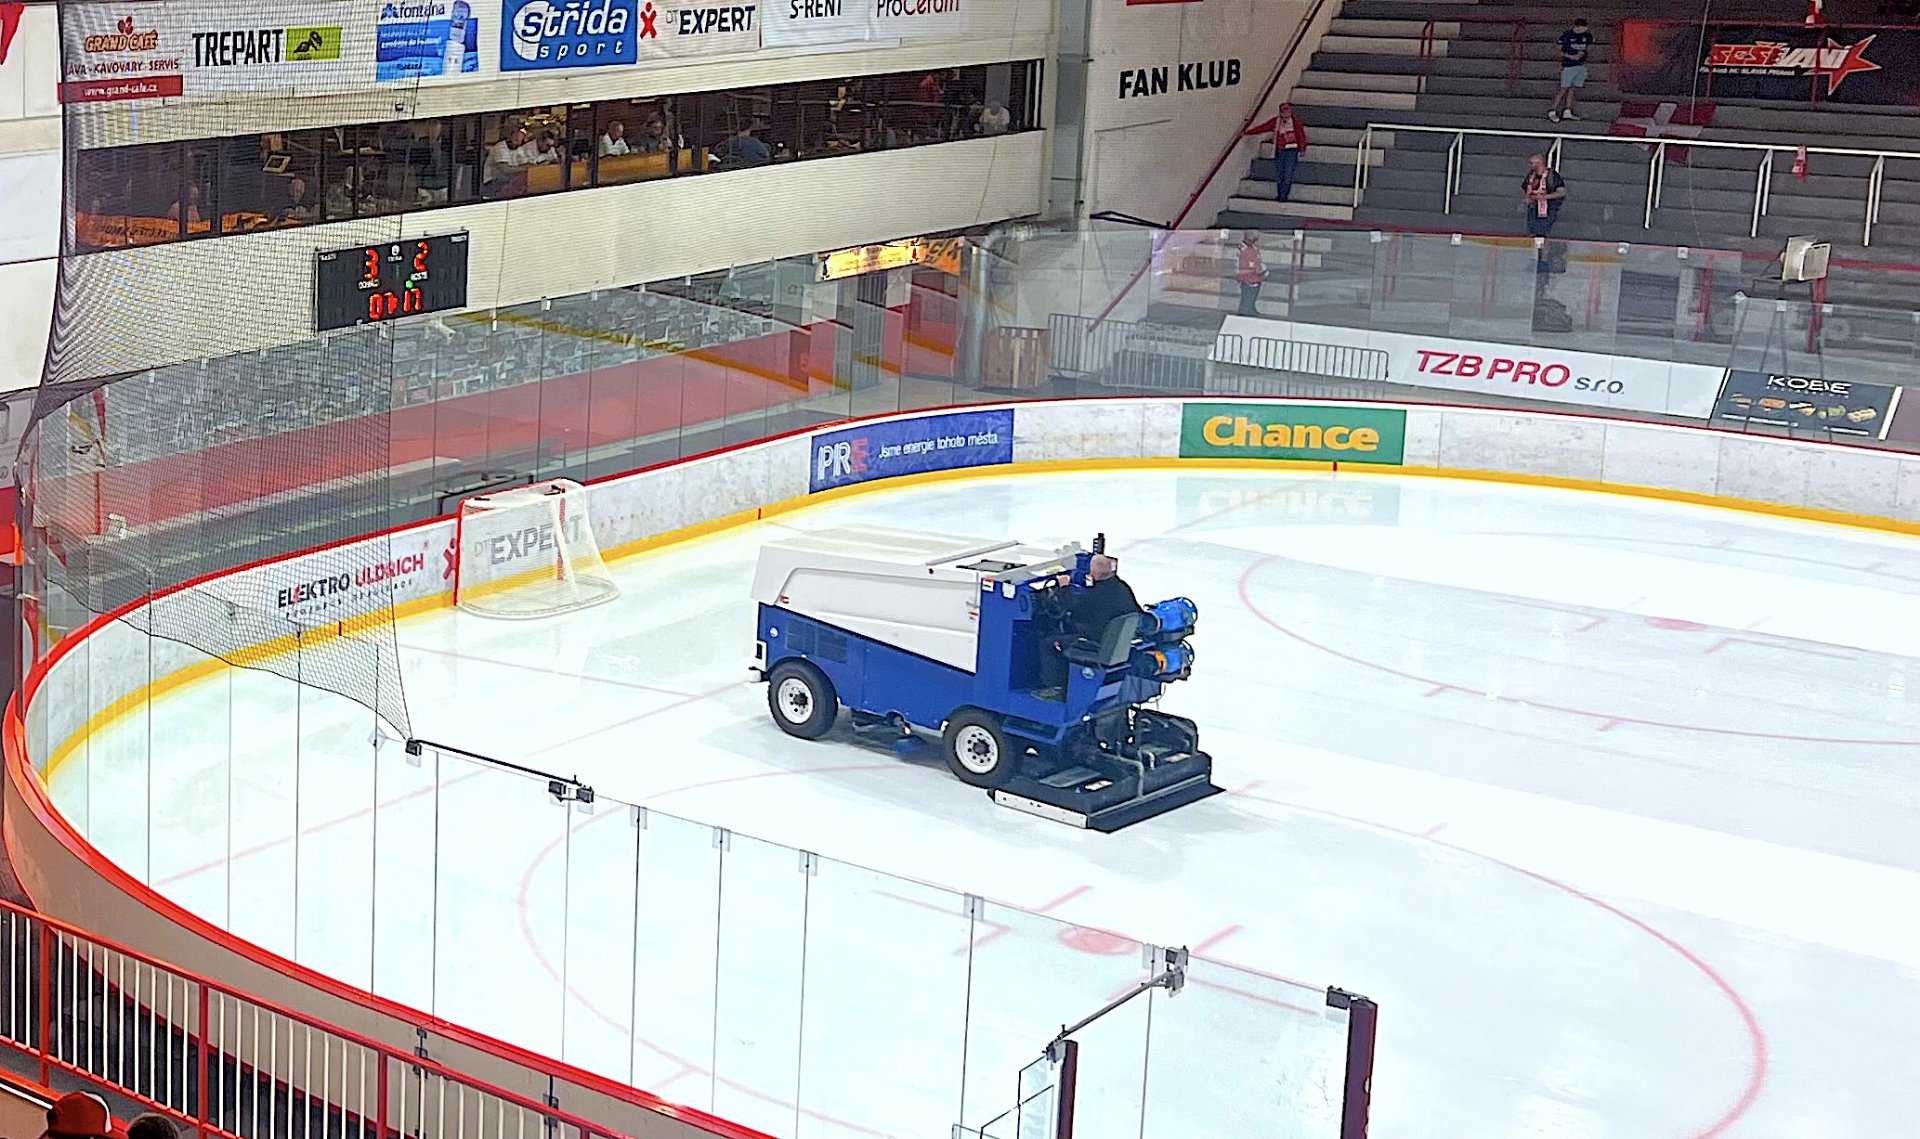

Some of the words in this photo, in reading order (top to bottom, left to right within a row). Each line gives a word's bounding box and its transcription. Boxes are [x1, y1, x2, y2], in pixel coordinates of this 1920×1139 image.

[678, 5, 756, 35] EXPERT
[85, 34, 128, 53] GRAND
[128, 29, 159, 51] CAFÉ
[191, 28, 284, 68] TREPART
[540, 40, 622, 60] sport
[148, 58, 180, 71] SERVIS
[1119, 66, 1169, 99] FAN
[1177, 59, 1241, 91] KLUB
[363, 248, 380, 281] 3
[413, 241, 429, 272] 2
[1416, 350, 1483, 377] TZB
[1486, 358, 1570, 387] PRO
[1767, 374, 1852, 395] KOBE
[878, 443, 901, 459] Jsme
[902, 438, 934, 455] energie
[937, 435, 965, 450] tohoto
[1203, 415, 1380, 451] Chance
[817, 438, 869, 481] PRE
[491, 515, 583, 565] EXPET
[278, 572, 351, 608] ELEKTRO
